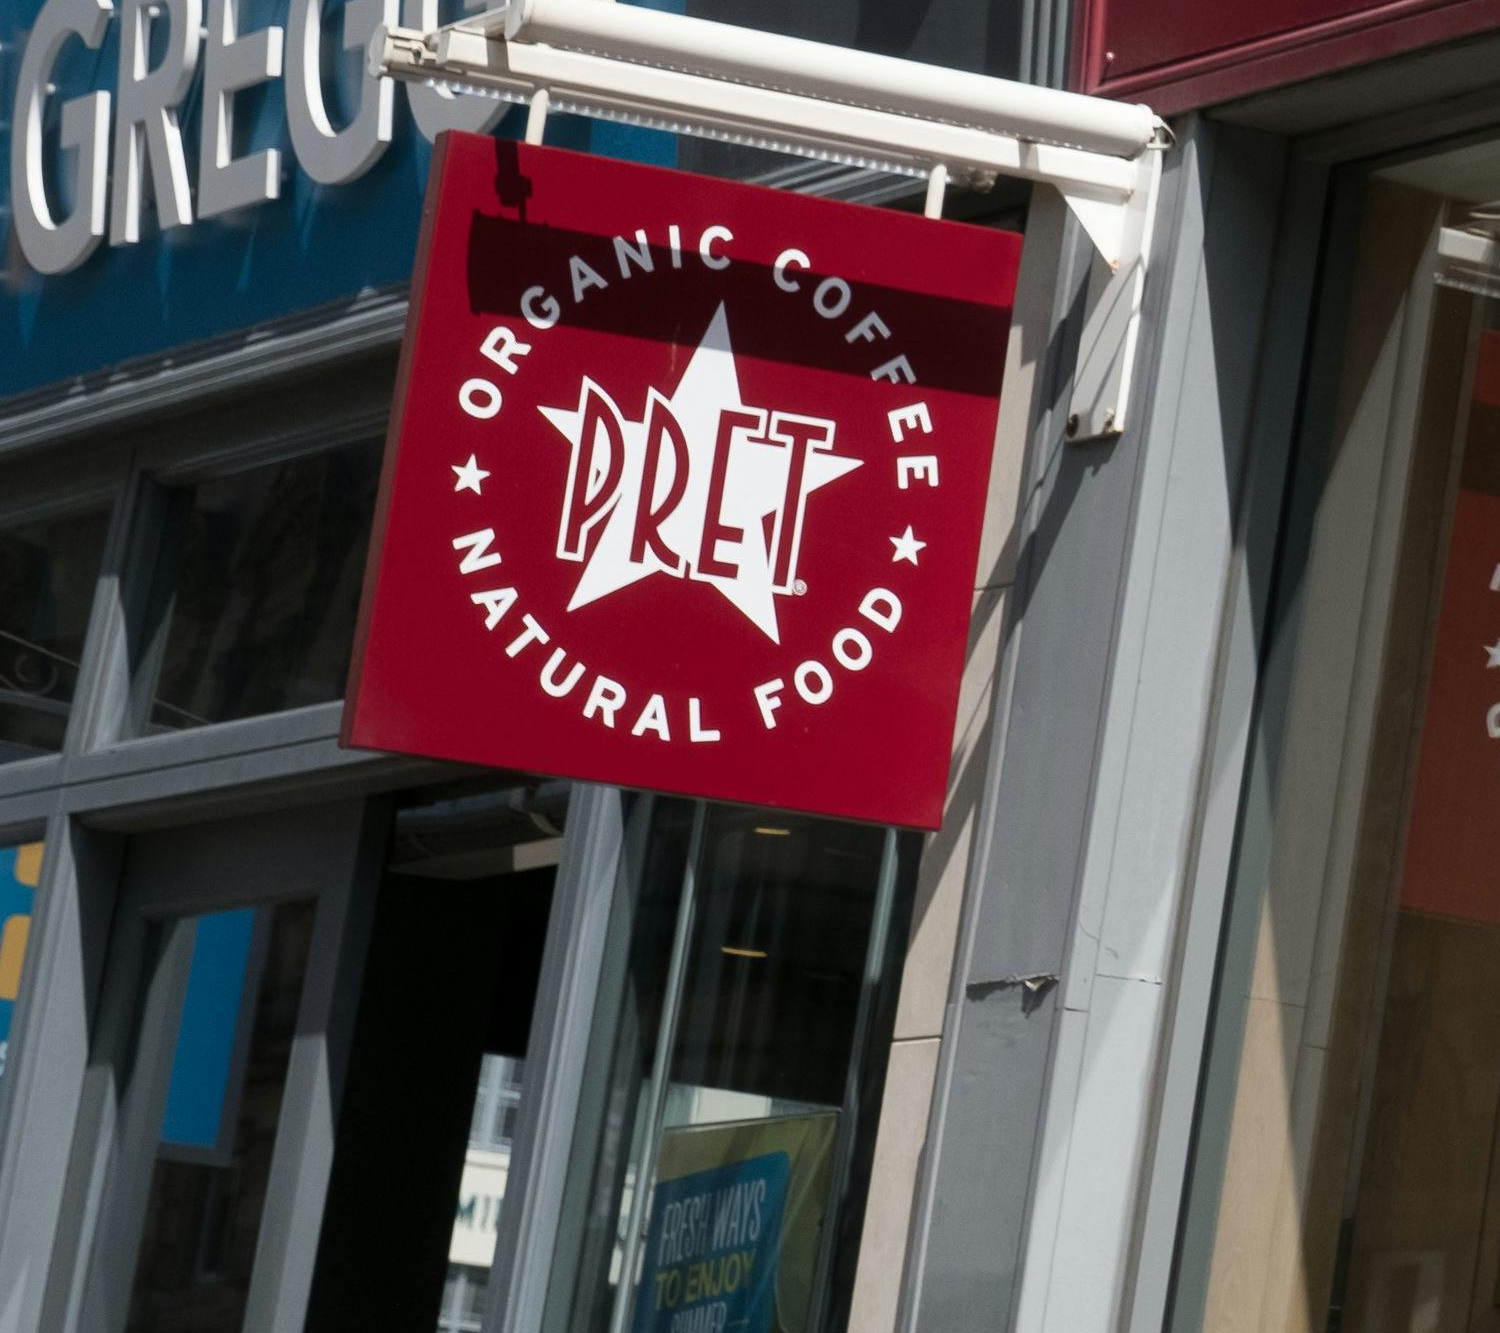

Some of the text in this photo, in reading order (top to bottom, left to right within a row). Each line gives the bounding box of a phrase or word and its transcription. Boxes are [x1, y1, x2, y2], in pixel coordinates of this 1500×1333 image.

[458, 224, 940, 490] ORGANIC COFFEE
[556, 375, 836, 597] PRET
[452, 528, 903, 743] NATURAL FOOD
[654, 1247, 758, 1312] TO ENJOY
[657, 1178, 767, 1266] FRESH WAYS
